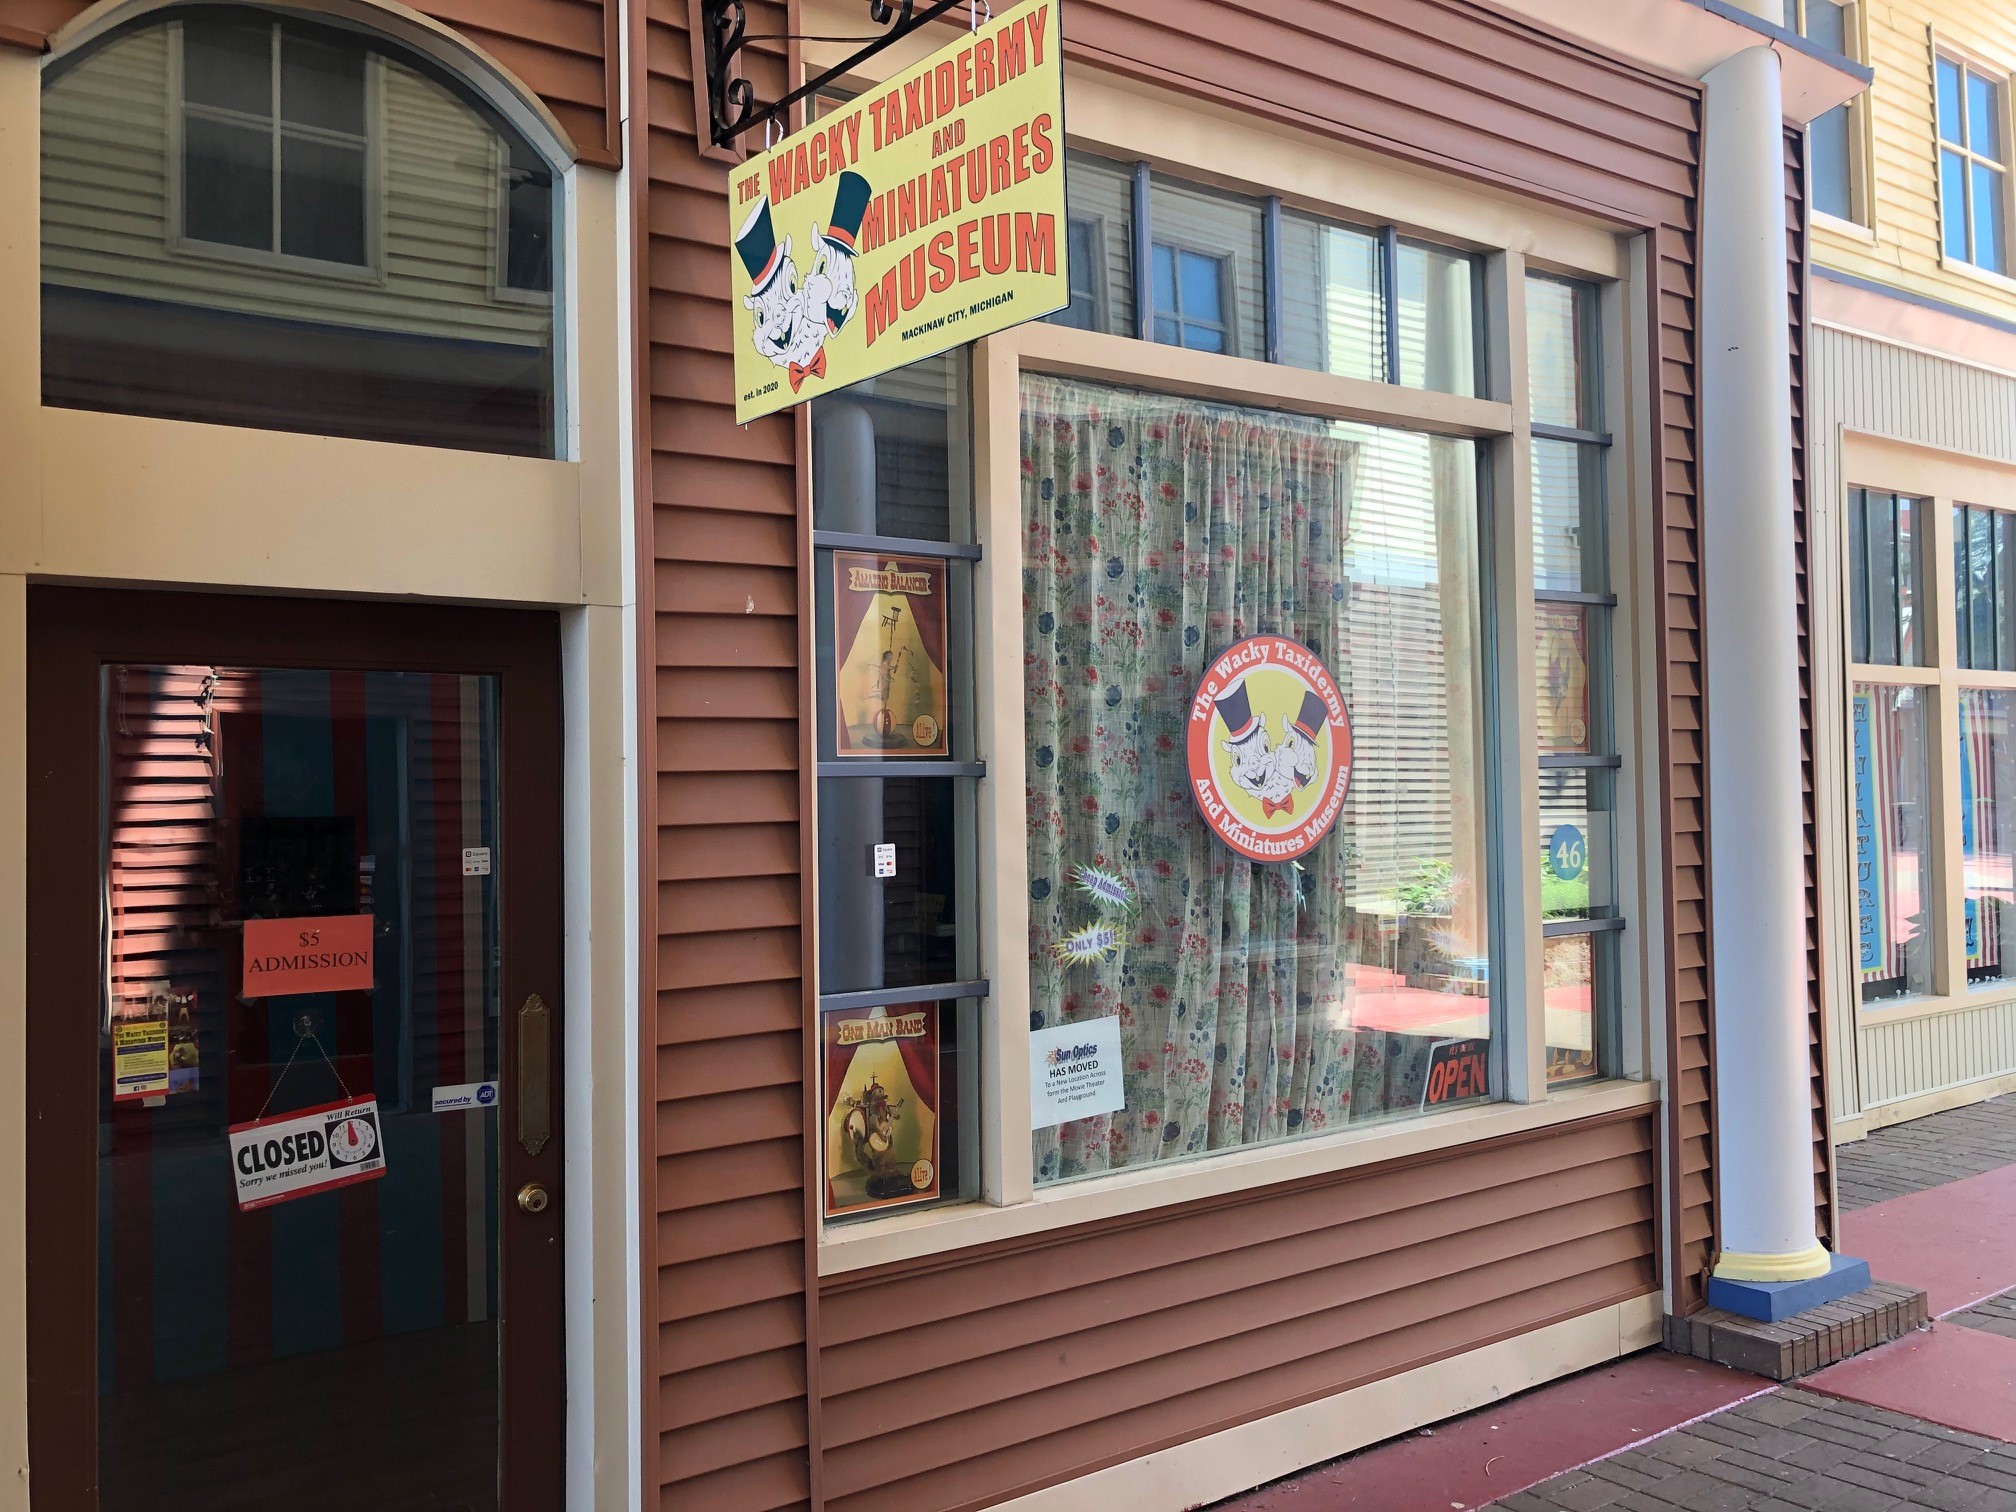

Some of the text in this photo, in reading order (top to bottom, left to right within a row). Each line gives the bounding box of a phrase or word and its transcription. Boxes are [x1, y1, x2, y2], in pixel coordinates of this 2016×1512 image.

[737, 4, 1048, 206] THE WACKY TAXIDERMY
[931, 118, 966, 159] AND
[861, 113, 1054, 255] MINIATURES
[865, 212, 1057, 348] MUSEUM
[901, 290, 1014, 341] MACKINAW CITY, MICHIGAN
[763, 381, 779, 394] 2020
[1192, 641, 1345, 728] The Wacky Taxidermy
[1196, 764, 1349, 856] And Miniatures Museum
[1556, 841, 1581, 869] 46
[299, 932, 320, 948] $5
[1066, 938, 1093, 953] ONLY
[249, 951, 368, 973] ADMISSION
[1056, 1043, 1098, 1062] Sun Optics
[1049, 1060, 1099, 1079] HAS MOVED
[1069, 1074, 1089, 1083] Location
[1428, 1052, 1486, 1104] OPEN
[326, 1106, 371, 1121] Will Return
[434, 1096, 472, 1105] secured by
[237, 1130, 325, 1175] CLOSED
[239, 1159, 328, 1189] Sorry we missed you!
